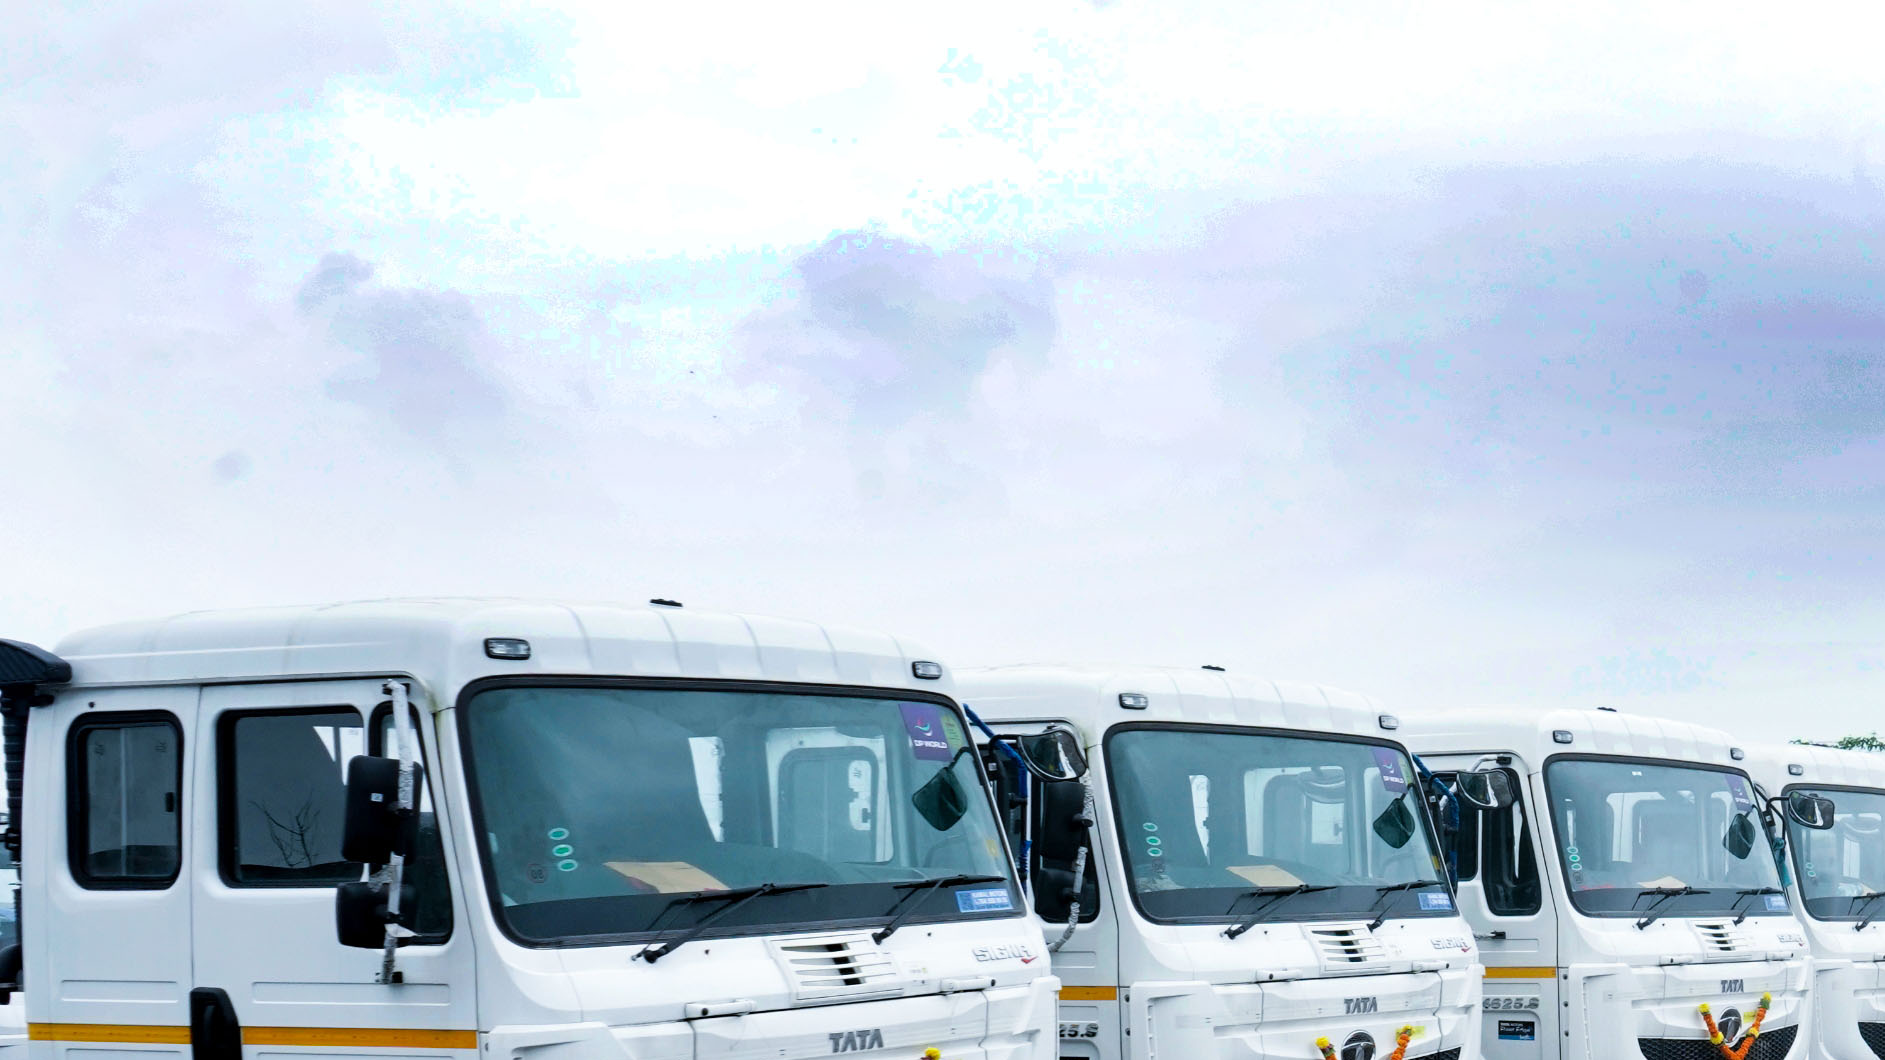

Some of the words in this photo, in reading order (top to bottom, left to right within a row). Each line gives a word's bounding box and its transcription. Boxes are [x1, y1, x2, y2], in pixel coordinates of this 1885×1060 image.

[972, 945, 1033, 963] SIGNA
[1720, 978, 1744, 993] TATA
[1343, 996, 1378, 1015] TATA
[1482, 997, 1540, 1010] 4625.S
[828, 1028, 884, 1054] TATA
